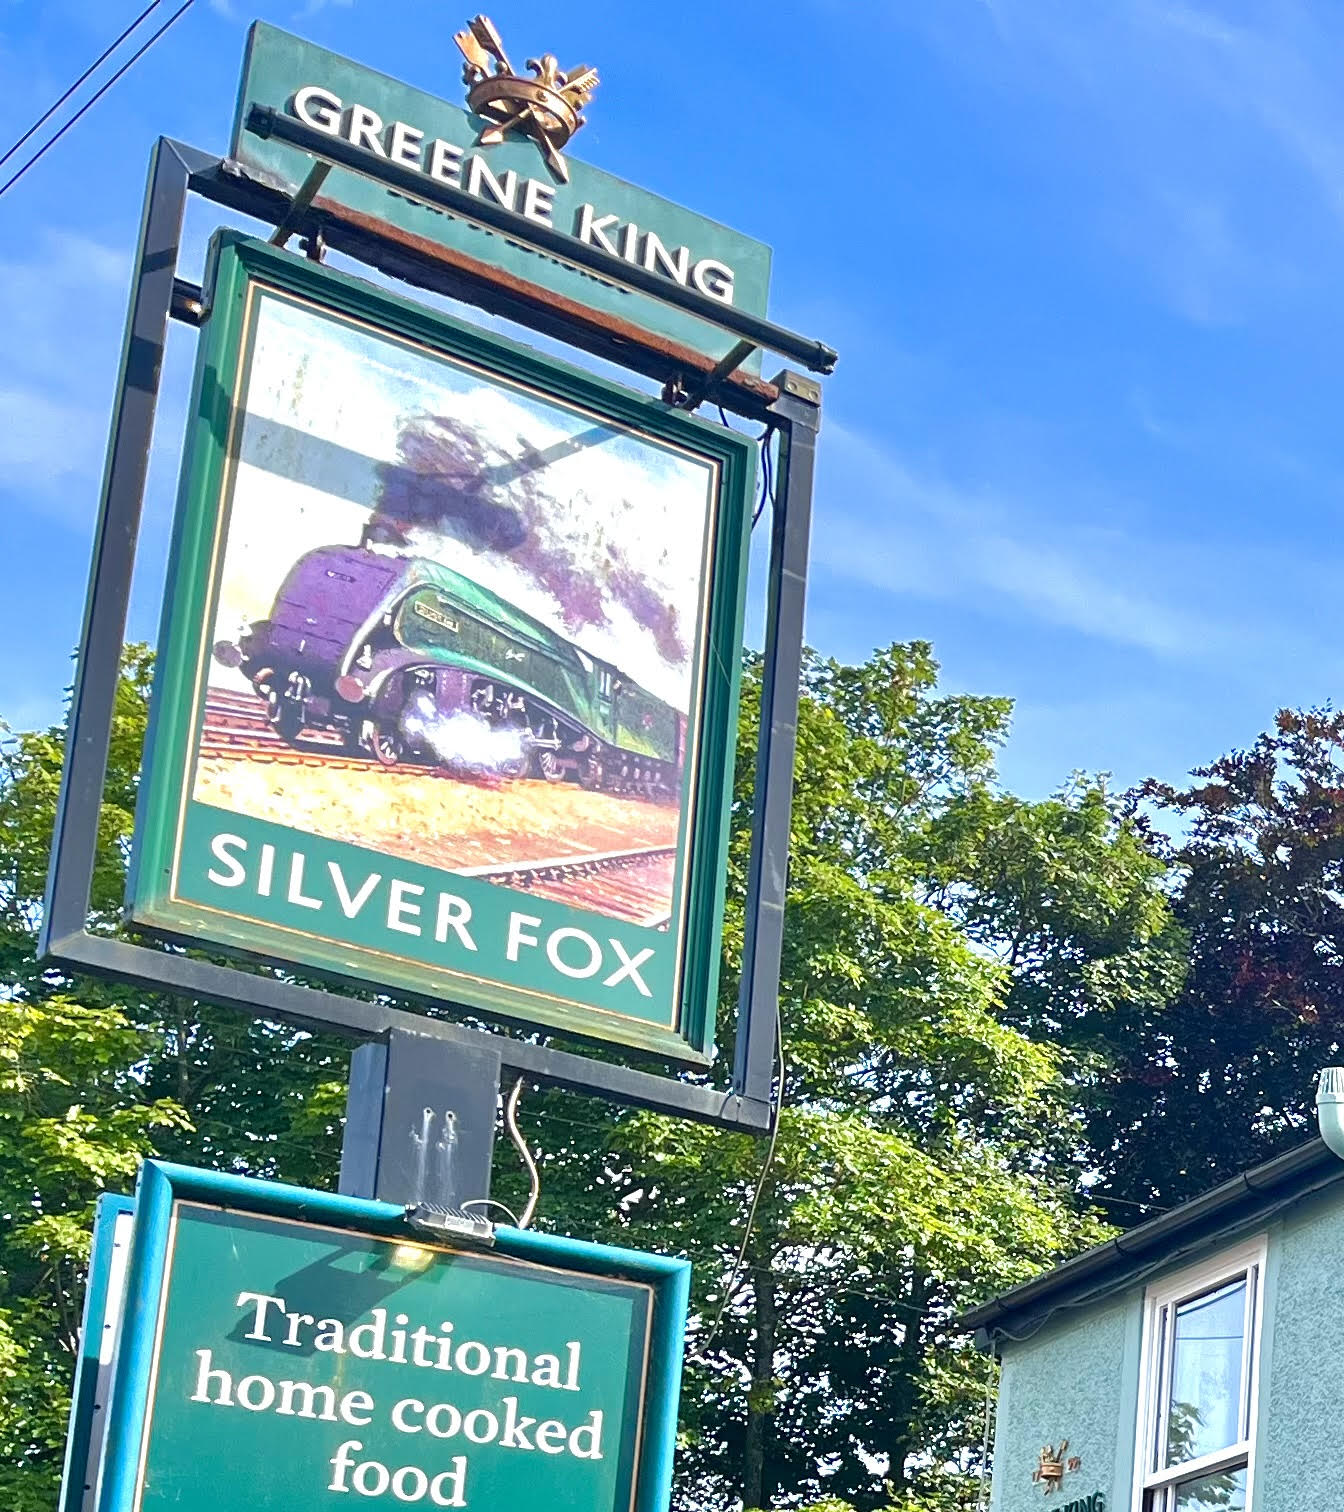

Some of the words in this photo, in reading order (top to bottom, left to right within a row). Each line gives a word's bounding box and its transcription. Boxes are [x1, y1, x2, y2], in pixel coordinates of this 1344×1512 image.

[295, 86, 556, 229] GREENE
[579, 203, 735, 305] KING
[207, 833, 478, 951] SILVER
[506, 912, 655, 998] FOX
[237, 1291, 581, 1392] Traditional
[190, 1350, 374, 1427] home
[392, 1397, 605, 1460] cooked
[328, 1442, 468, 1508] food
